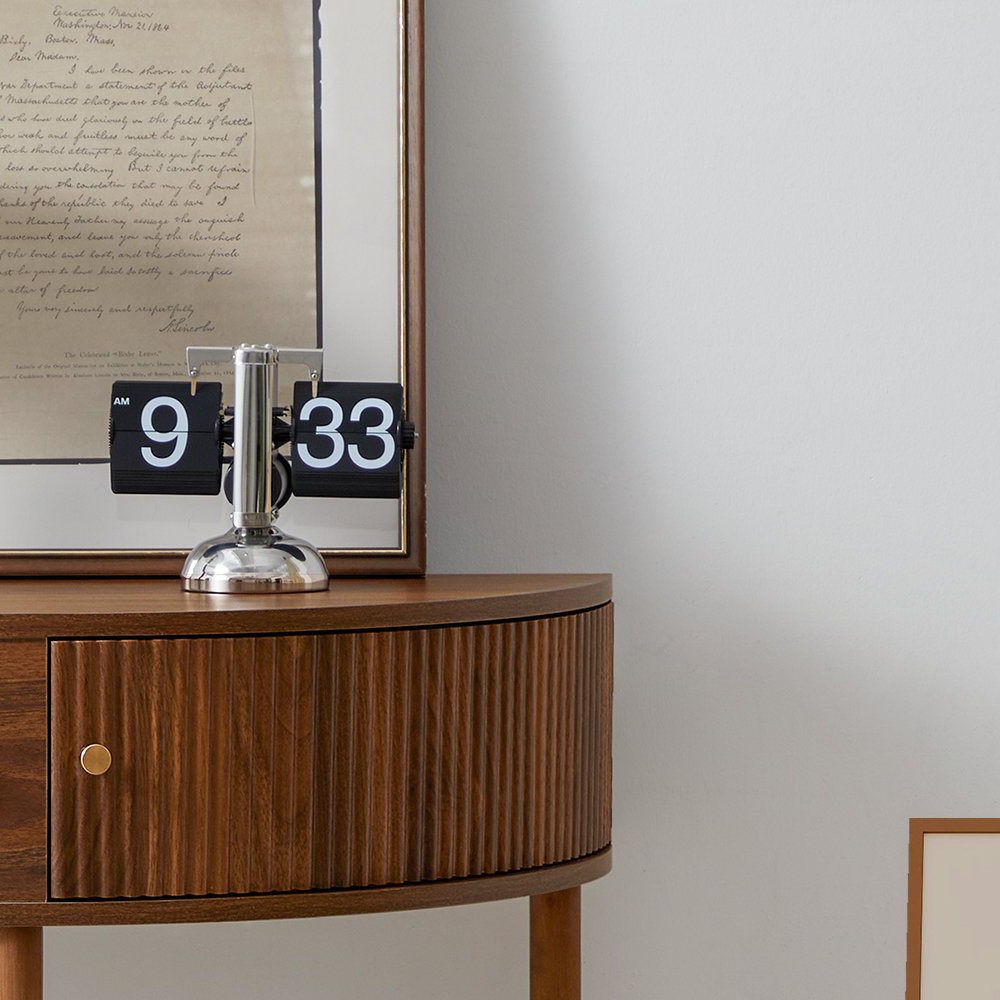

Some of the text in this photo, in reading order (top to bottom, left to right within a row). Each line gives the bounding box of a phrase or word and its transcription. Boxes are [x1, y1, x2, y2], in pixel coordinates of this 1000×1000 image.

[200, 63, 216, 73] the
[20, 79, 78, 92] Department
[99, 81, 156, 89] statement
[170, 80, 188, 88] the
[151, 96, 169, 105] the
[173, 97, 211, 107] mother
[147, 112, 168, 123] the
[113, 397, 130, 406] AM
[140, 396, 396, 470] 9 33
